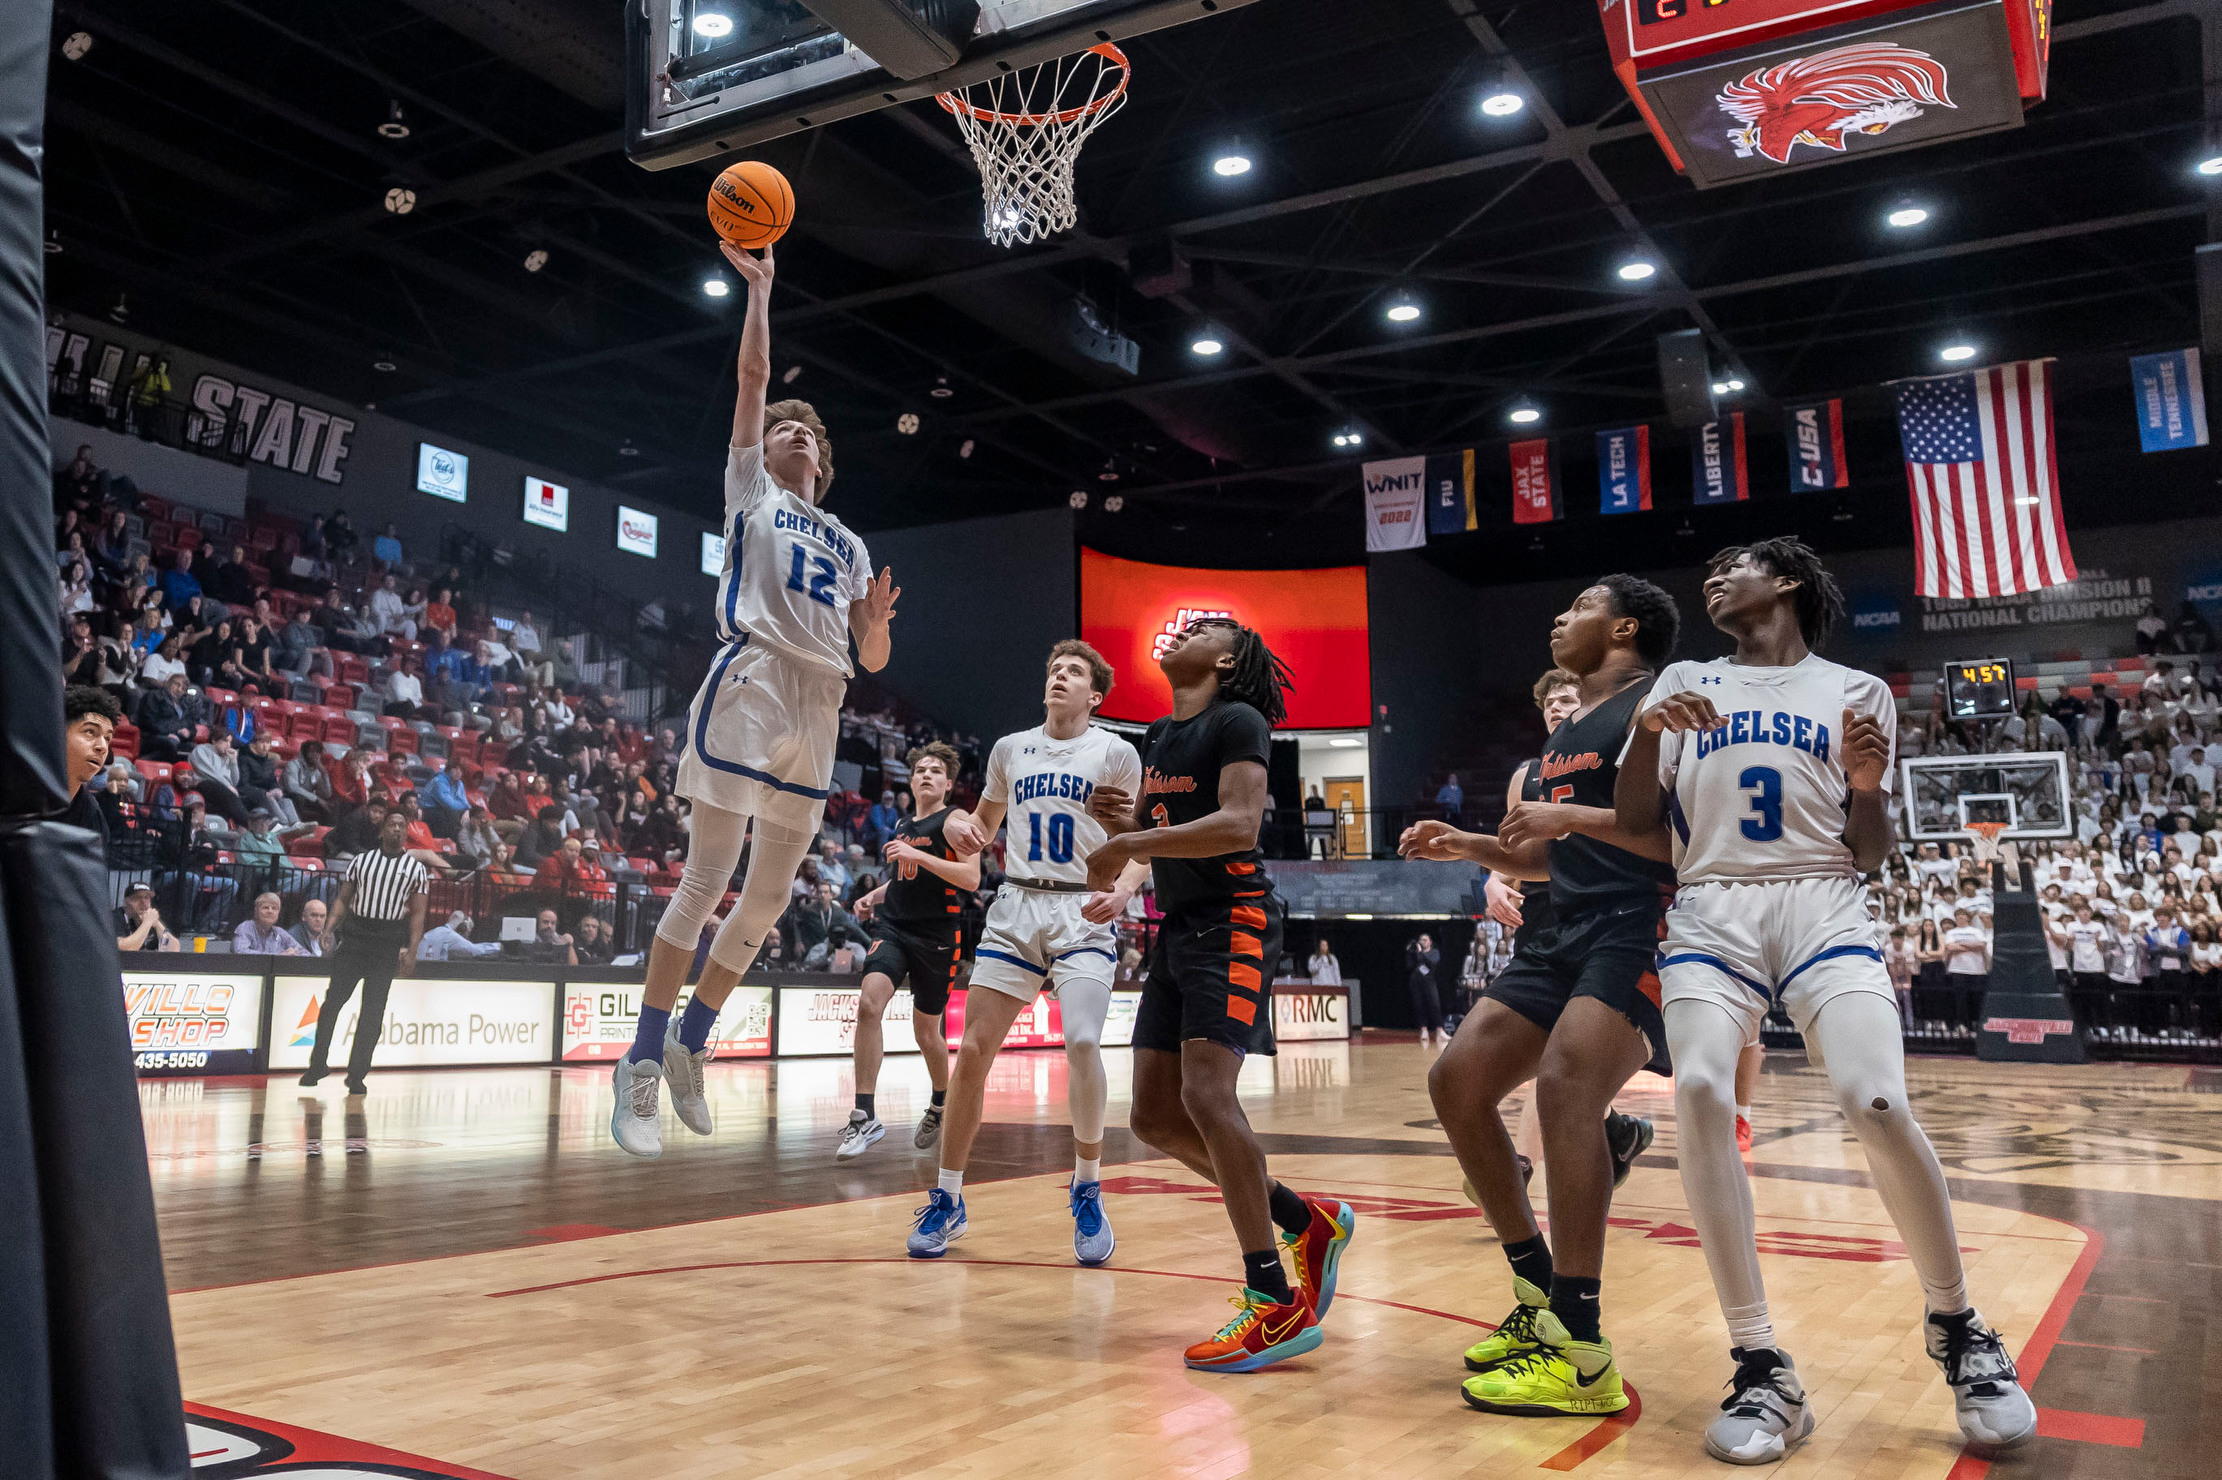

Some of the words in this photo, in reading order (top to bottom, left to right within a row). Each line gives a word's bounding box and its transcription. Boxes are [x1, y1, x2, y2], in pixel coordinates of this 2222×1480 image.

[714, 177, 755, 214] Wilson
[2160, 361, 2183, 440] TENNESSEE
[188, 374, 355, 484] STATE
[1610, 436, 1626, 480] TECH
[1702, 421, 1723, 497] LIBERTY
[1367, 472, 1421, 494] WNIT
[1442, 480, 1454, 507] FIU
[1517, 466, 1530, 499] JAX
[1530, 455, 1547, 508] STATE
[1613, 484, 1628, 507] LA
[774, 508, 854, 574] CHELSEA
[786, 542, 836, 608] 12
[2040, 579, 2131, 602] DIVISION
[1854, 612, 1900, 626] NCAA
[1923, 608, 2021, 631] NATIONAL
[1697, 710, 1829, 765] CHELSEA
[1738, 764, 1785, 843] 3
[1028, 812, 1075, 863] 10
[123, 984, 234, 1015] VILLE
[1293, 993, 1337, 1023] RMC
[131, 1017, 229, 1047] SHOP
[468, 1013, 540, 1045] Power
[135, 1052, 208, 1069] 435-5050
